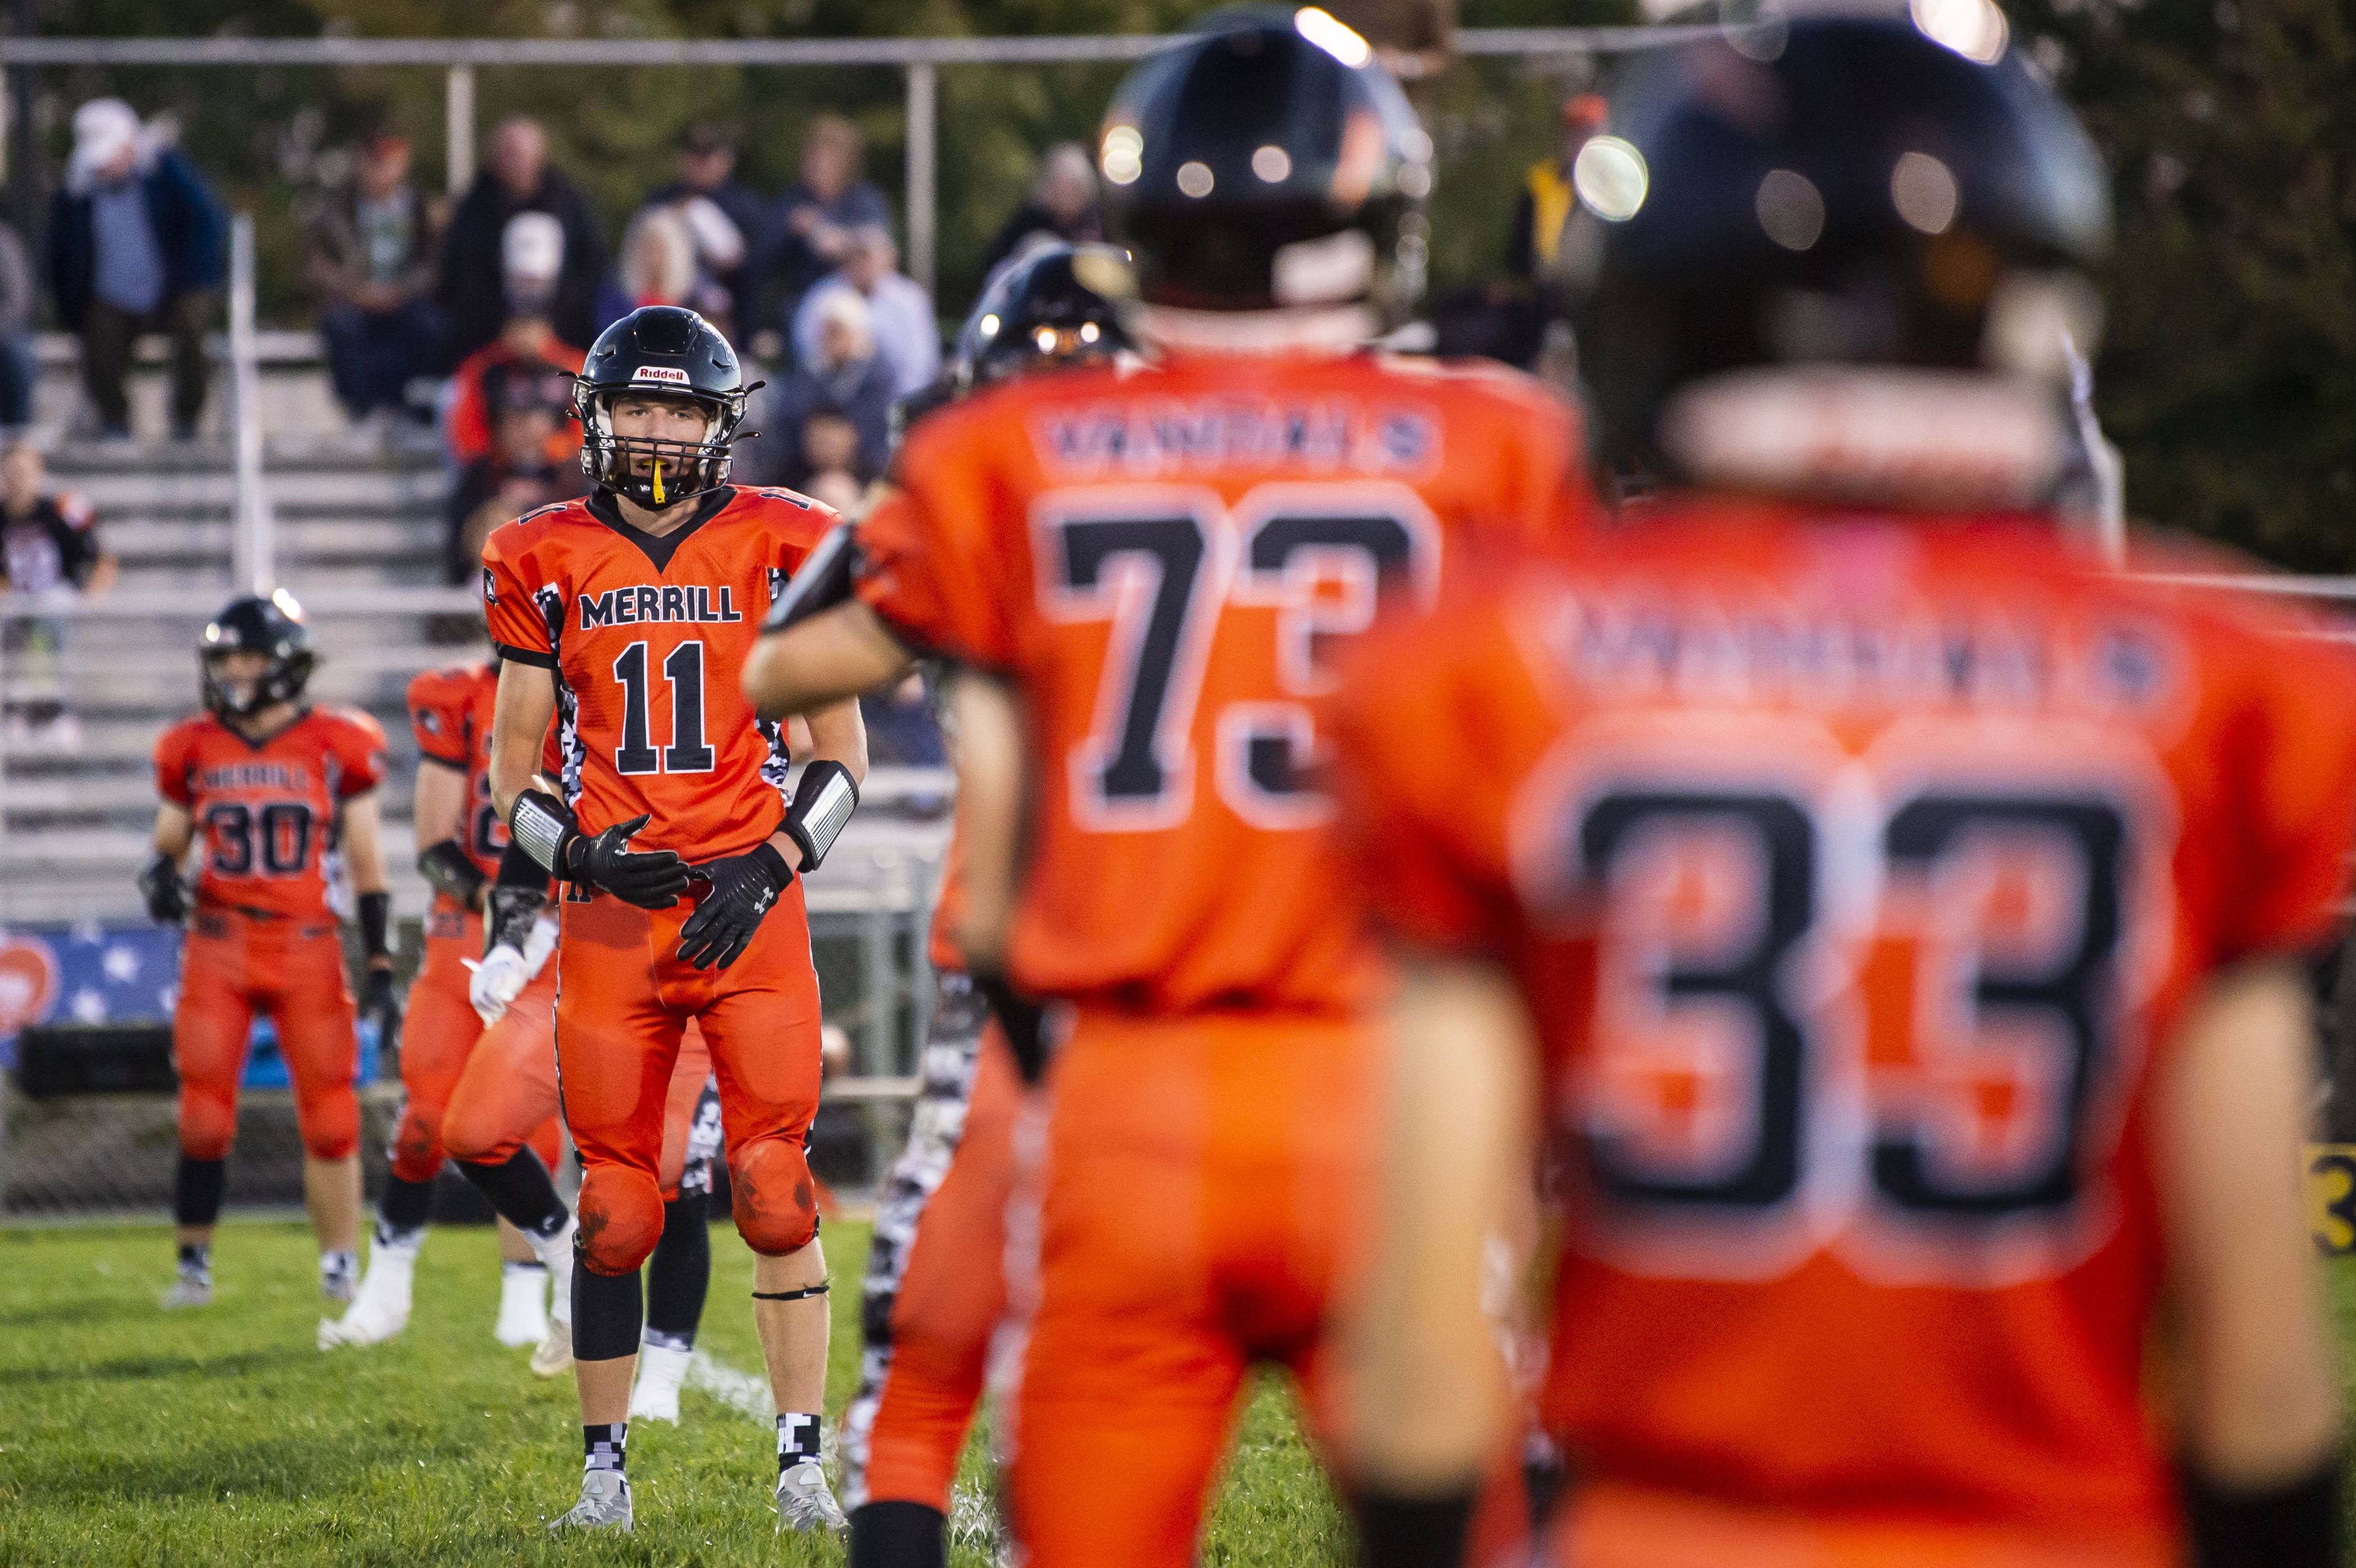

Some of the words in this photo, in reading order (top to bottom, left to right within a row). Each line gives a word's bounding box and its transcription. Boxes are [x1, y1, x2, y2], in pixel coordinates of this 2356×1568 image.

[639, 368, 684, 381] Riddell
[579, 584, 742, 630] MERRILL
[1034, 484, 1442, 831] 73
[613, 640, 715, 775] 11
[205, 801, 314, 881] 30
[1528, 725, 2172, 1276] 33
